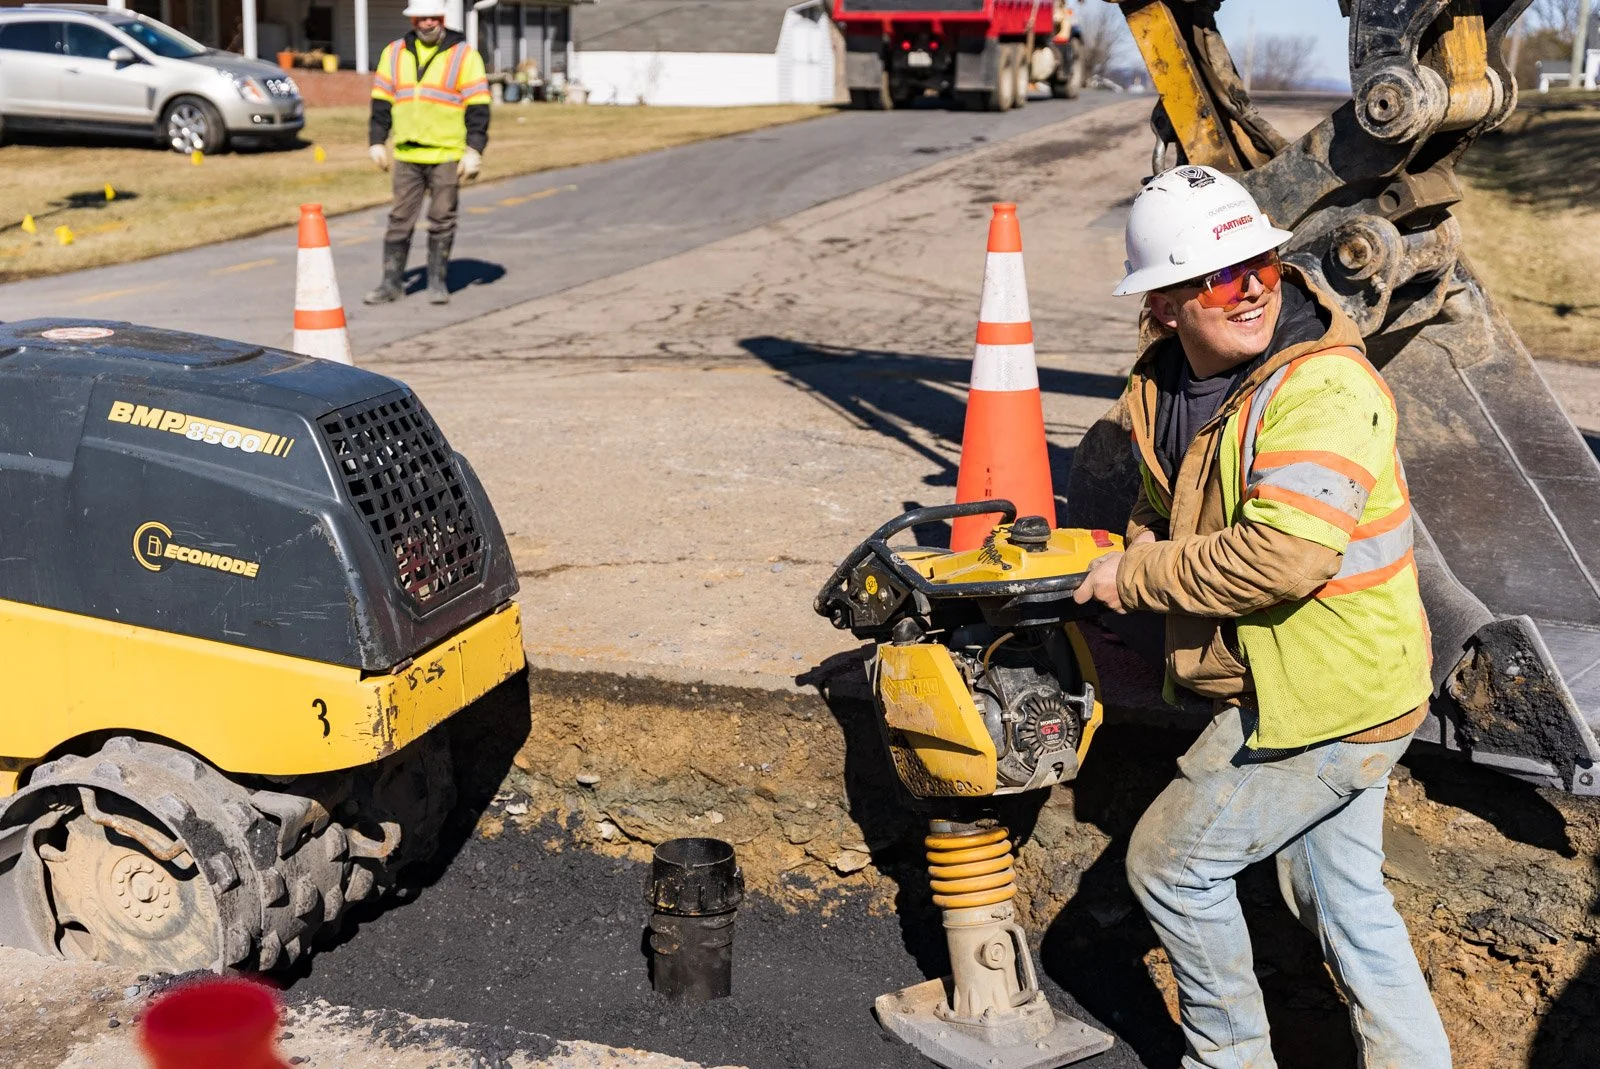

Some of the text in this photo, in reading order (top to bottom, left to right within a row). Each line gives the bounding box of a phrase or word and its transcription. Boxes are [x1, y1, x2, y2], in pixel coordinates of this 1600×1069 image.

[163, 543, 260, 578] ECOMODE
[311, 697, 331, 738] 3
[1040, 718, 1062, 726] HONDA
[1041, 723, 1061, 735] GX
